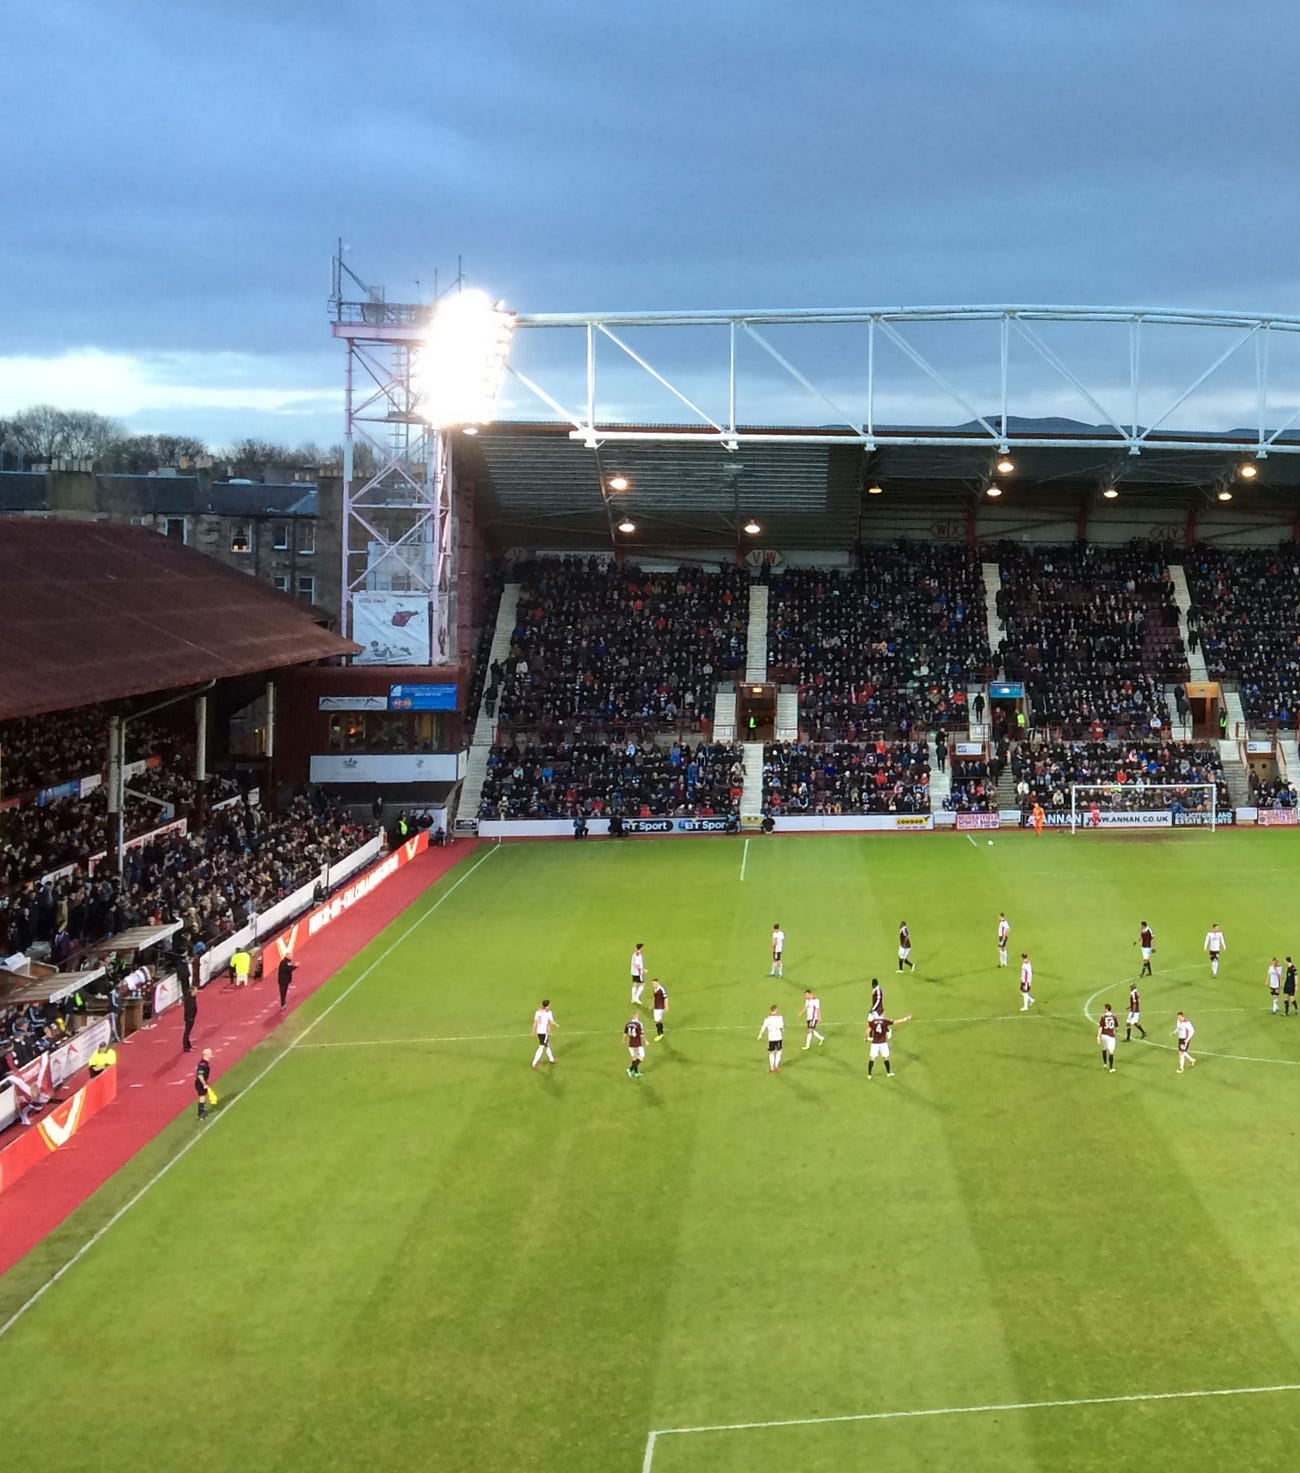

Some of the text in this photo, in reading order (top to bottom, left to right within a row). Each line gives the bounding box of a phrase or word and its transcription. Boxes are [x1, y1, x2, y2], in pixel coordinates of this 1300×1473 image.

[639, 821, 668, 832] Sport
[684, 820, 730, 831] BT Spor
[875, 1023, 883, 1034] 4
[1104, 1018, 1115, 1029] 30
[627, 1026, 638, 1038] 14
